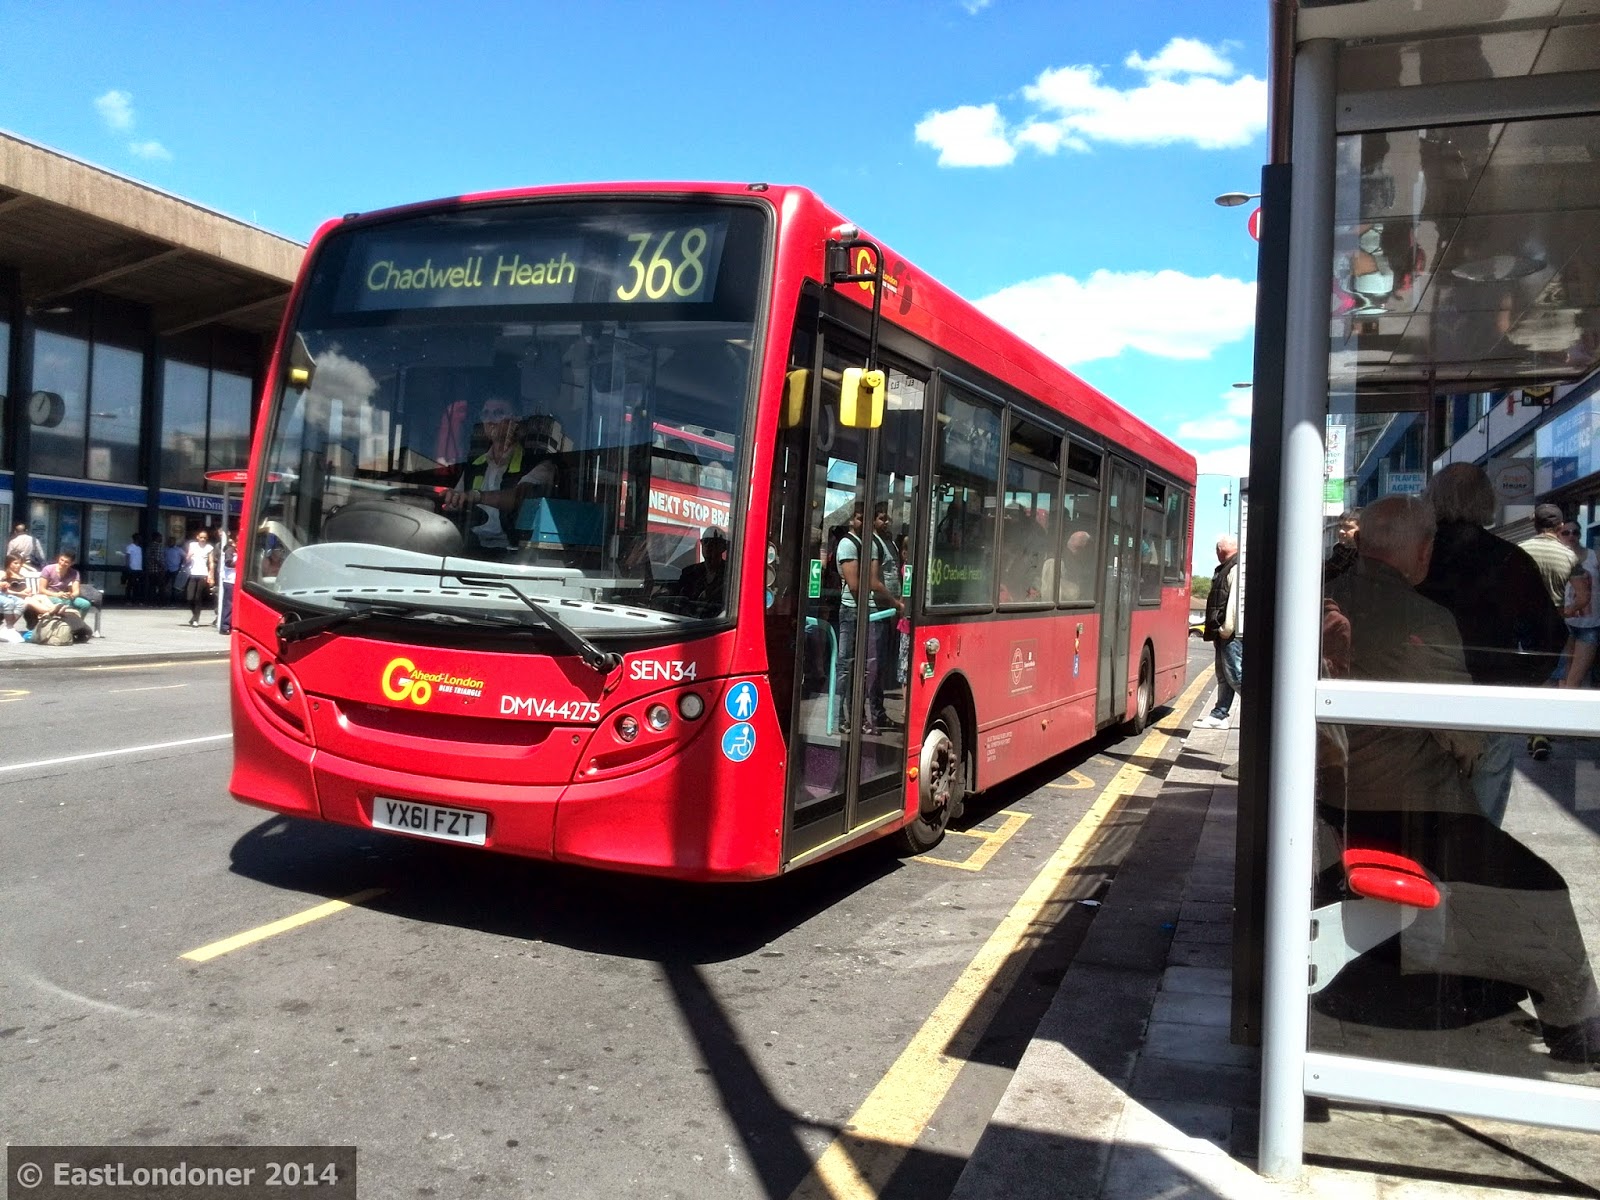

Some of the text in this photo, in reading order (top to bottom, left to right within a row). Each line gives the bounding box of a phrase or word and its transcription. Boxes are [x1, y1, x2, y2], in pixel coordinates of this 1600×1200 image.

[367, 228, 707, 301] Chadwell Heath 368
[1391, 474, 1423, 482] TRAVEL
[186, 496, 233, 511] WHSmih
[649, 489, 681, 515] NEXT
[682, 499, 710, 523] STOP
[382, 657, 432, 705] Go
[629, 660, 697, 682] SEN34
[438, 684, 482, 698] BLUE TRIANGLE
[500, 695, 601, 723] DMV44275
[385, 801, 475, 837] YX61 FZT
